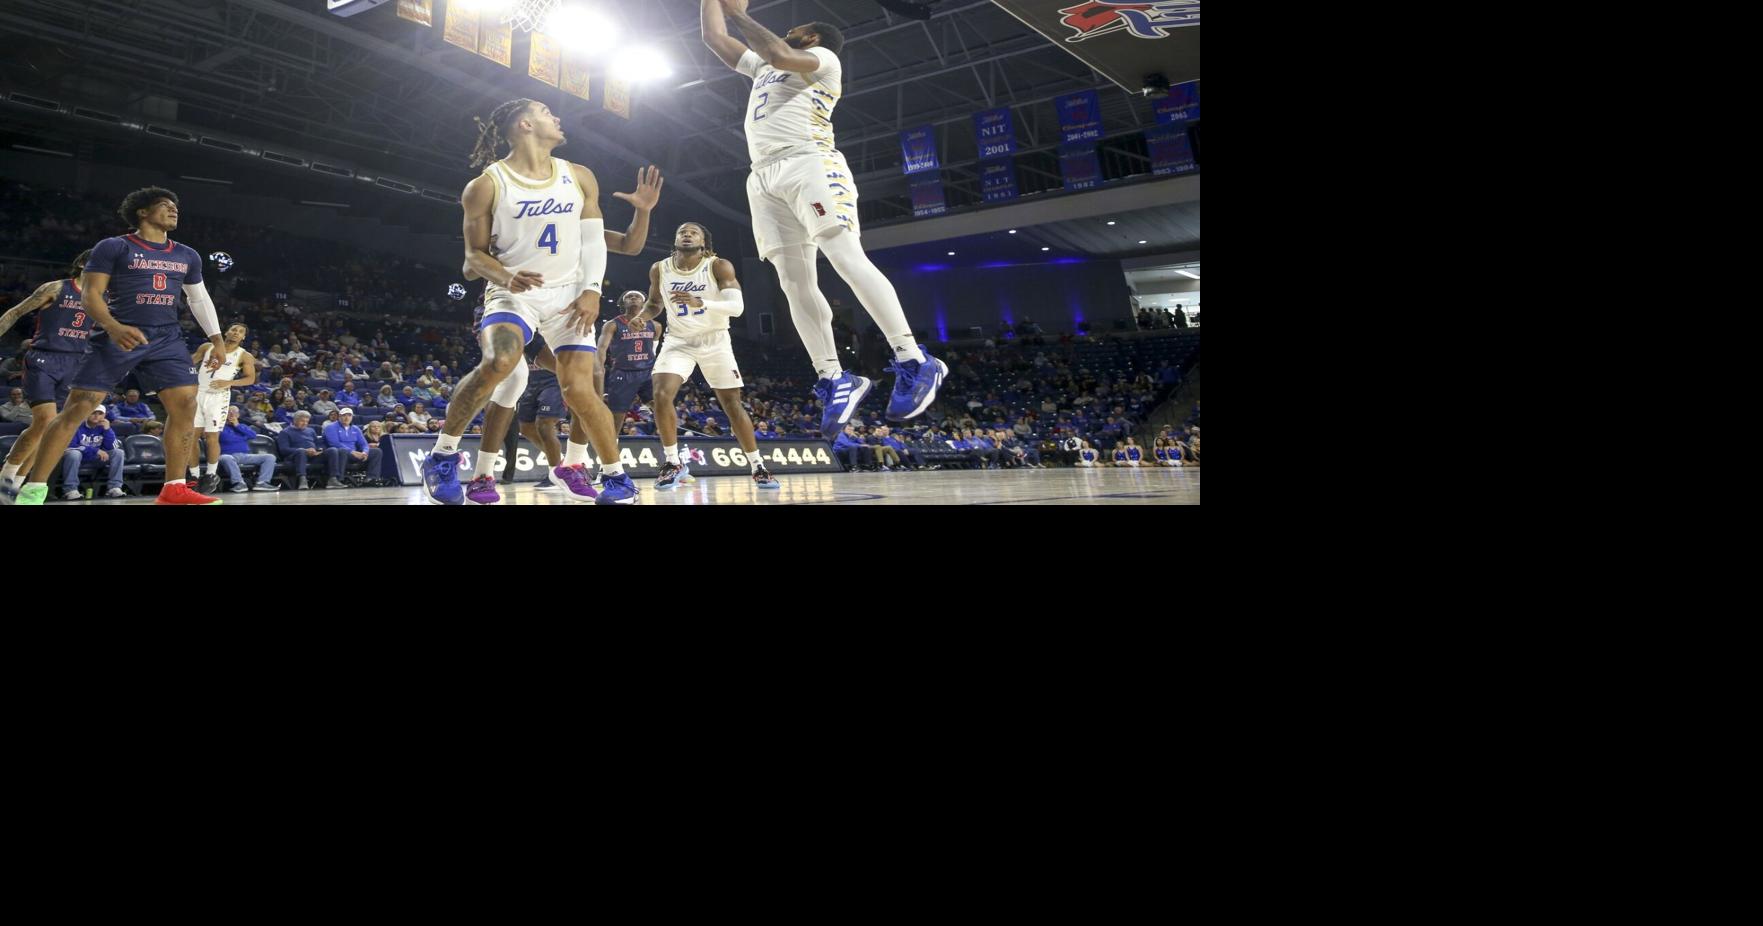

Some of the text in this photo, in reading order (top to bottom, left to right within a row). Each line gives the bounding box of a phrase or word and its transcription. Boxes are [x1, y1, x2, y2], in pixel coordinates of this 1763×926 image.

[754, 71, 792, 90] ulsa
[753, 92, 769, 121] 2
[982, 124, 1006, 136] NIT
[985, 143, 1010, 155] 2001
[513, 198, 574, 219] Tulsa
[537, 223, 558, 255] 4
[128, 259, 188, 273] JACKSON
[670, 281, 707, 293] Tulsa
[136, 294, 174, 305] STATE
[72, 312, 86, 327] 3
[711, 447, 831, 467] 66-4444
